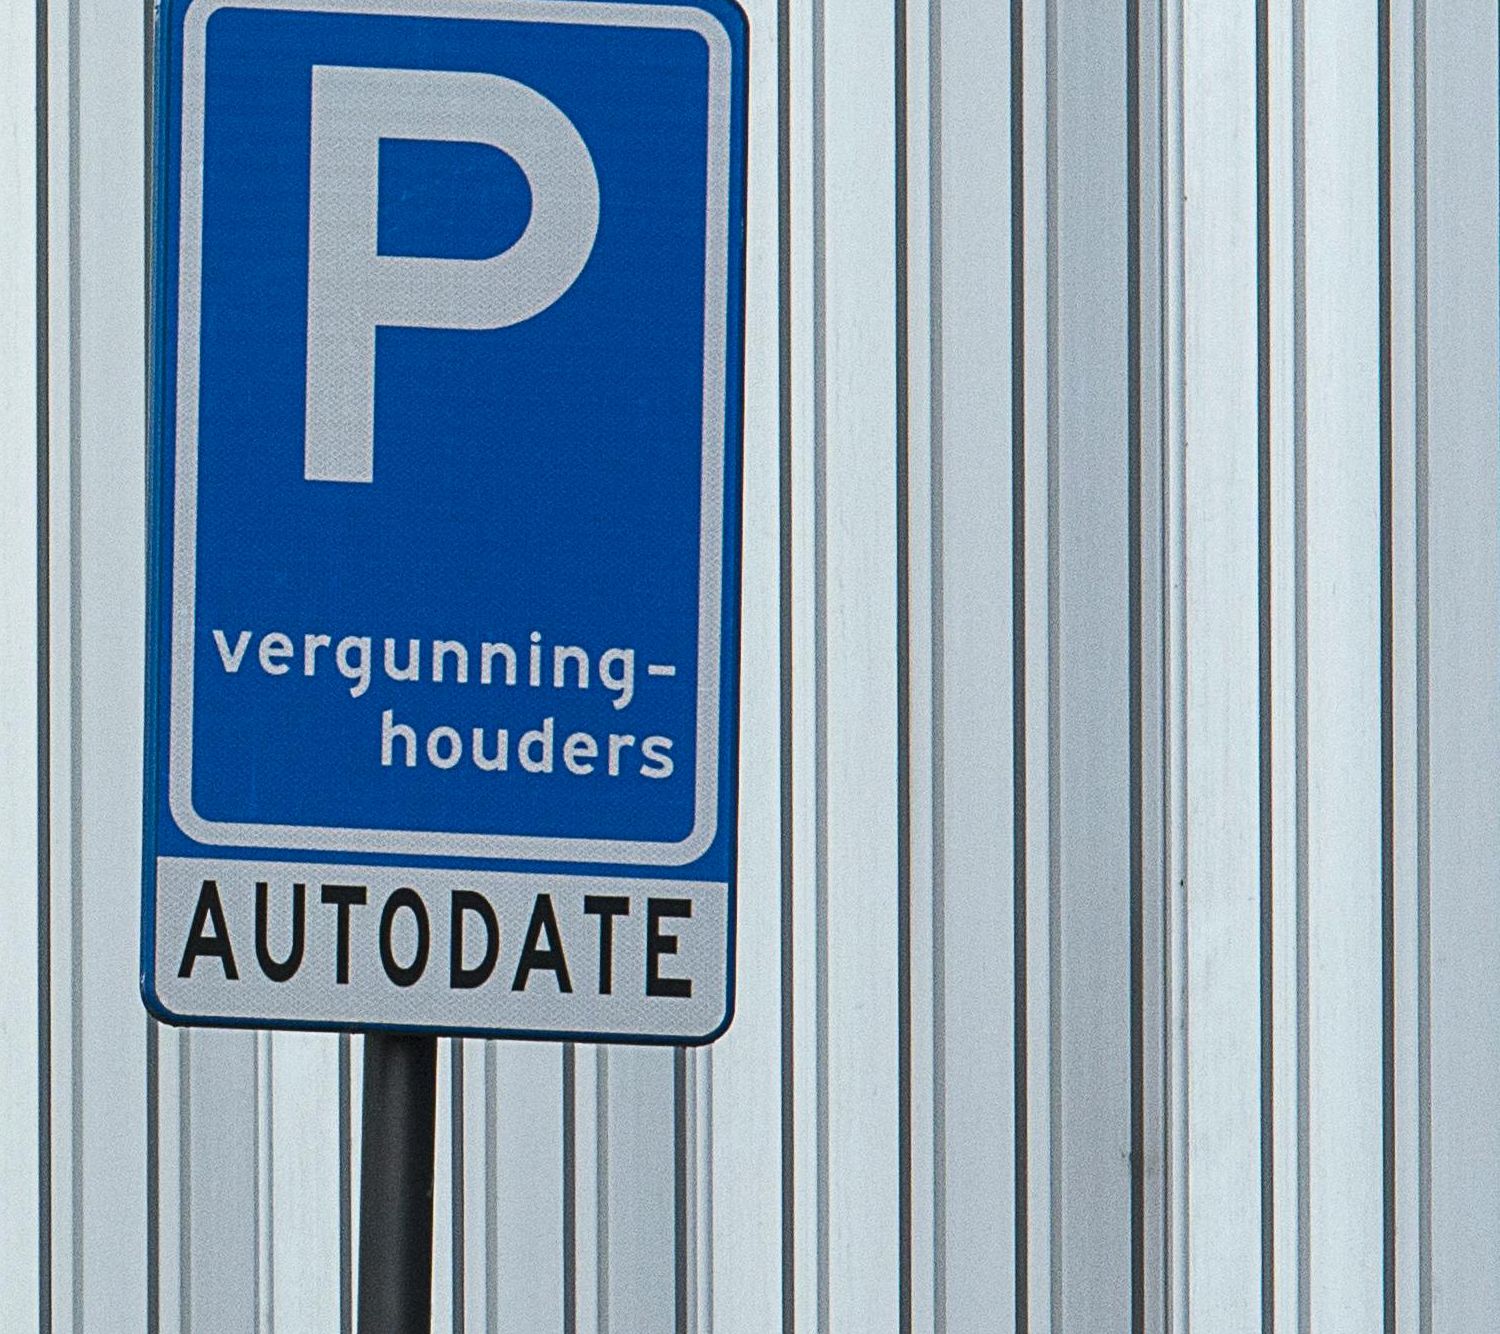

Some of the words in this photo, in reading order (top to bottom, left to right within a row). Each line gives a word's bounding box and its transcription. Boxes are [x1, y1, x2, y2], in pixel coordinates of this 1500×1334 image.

[303, 64, 600, 483] P
[212, 628, 677, 709] vergunning-
[380, 709, 675, 779] houders
[177, 879, 692, 999] AUTODATE
